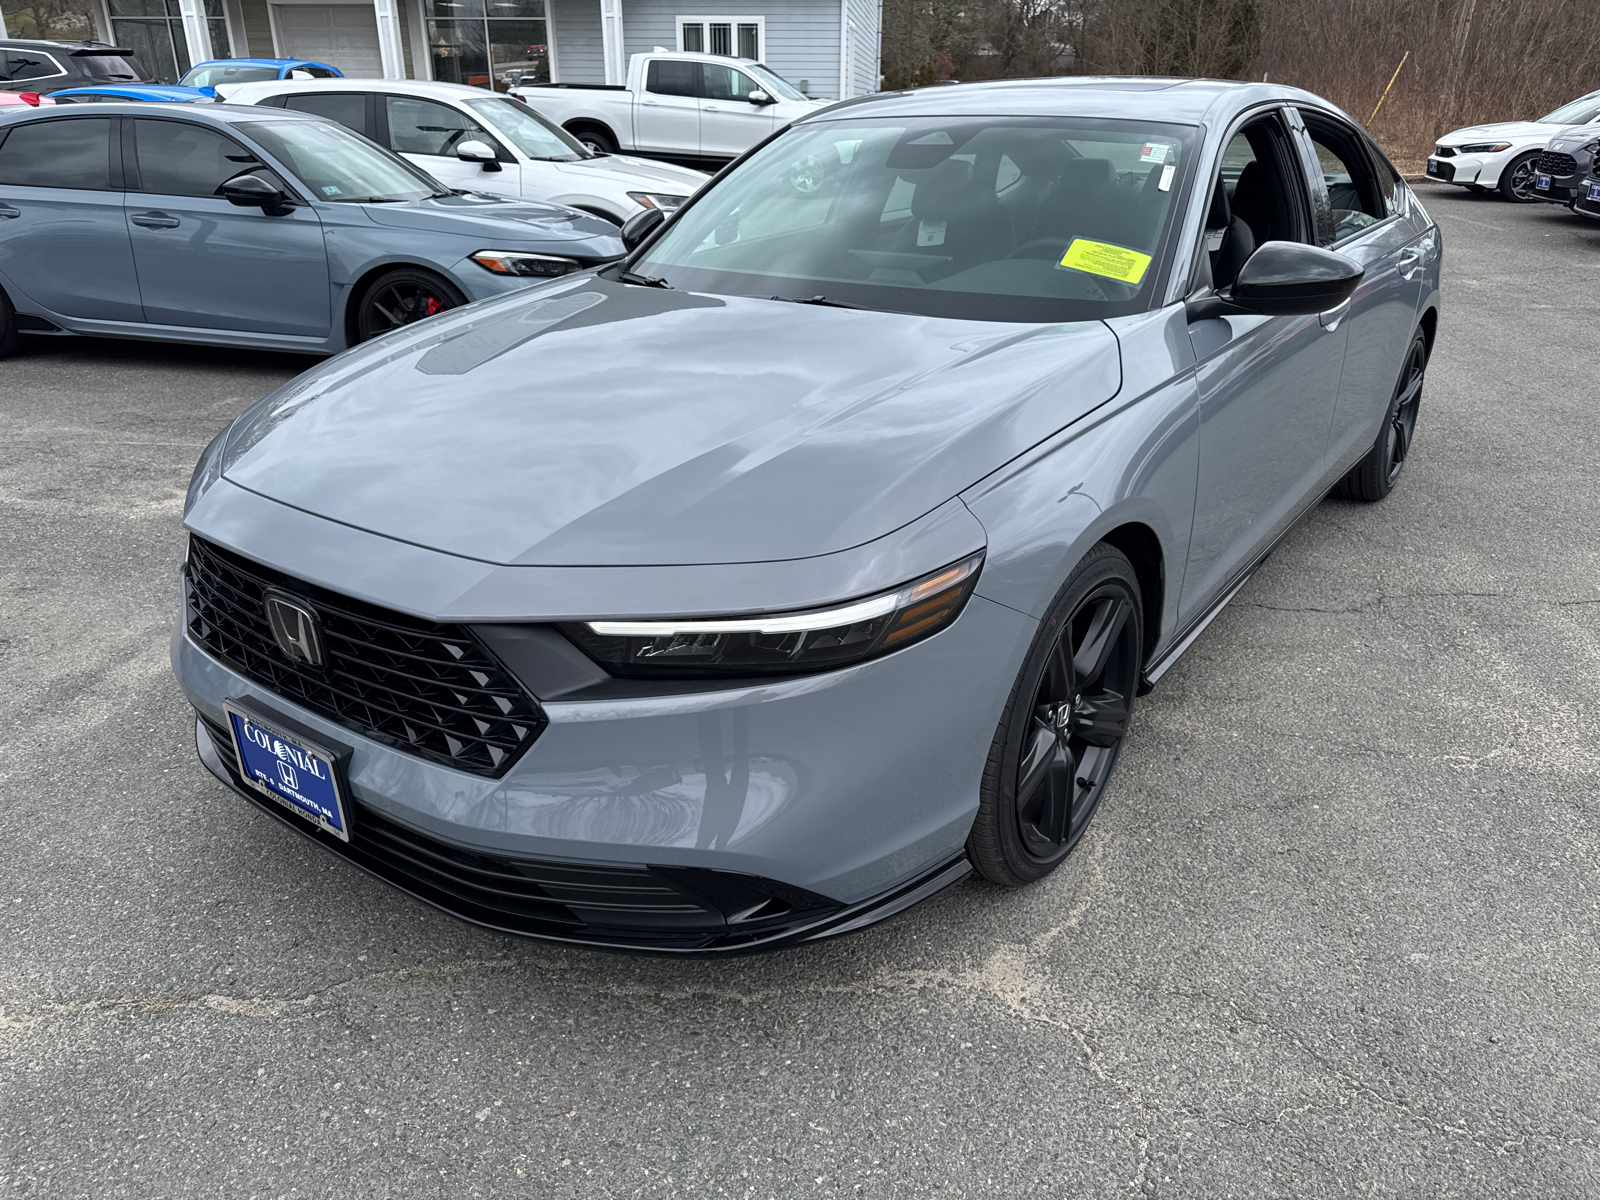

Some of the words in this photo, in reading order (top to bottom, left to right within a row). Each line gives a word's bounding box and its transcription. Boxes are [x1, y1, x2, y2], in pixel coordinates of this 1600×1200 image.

[243, 724, 326, 781] COLONIAL
[266, 790, 297, 812] COLONIAL
[298, 808, 321, 826] HONDA
[278, 783, 321, 813] DARTMOUTH,
[322, 807, 333, 819] MA
